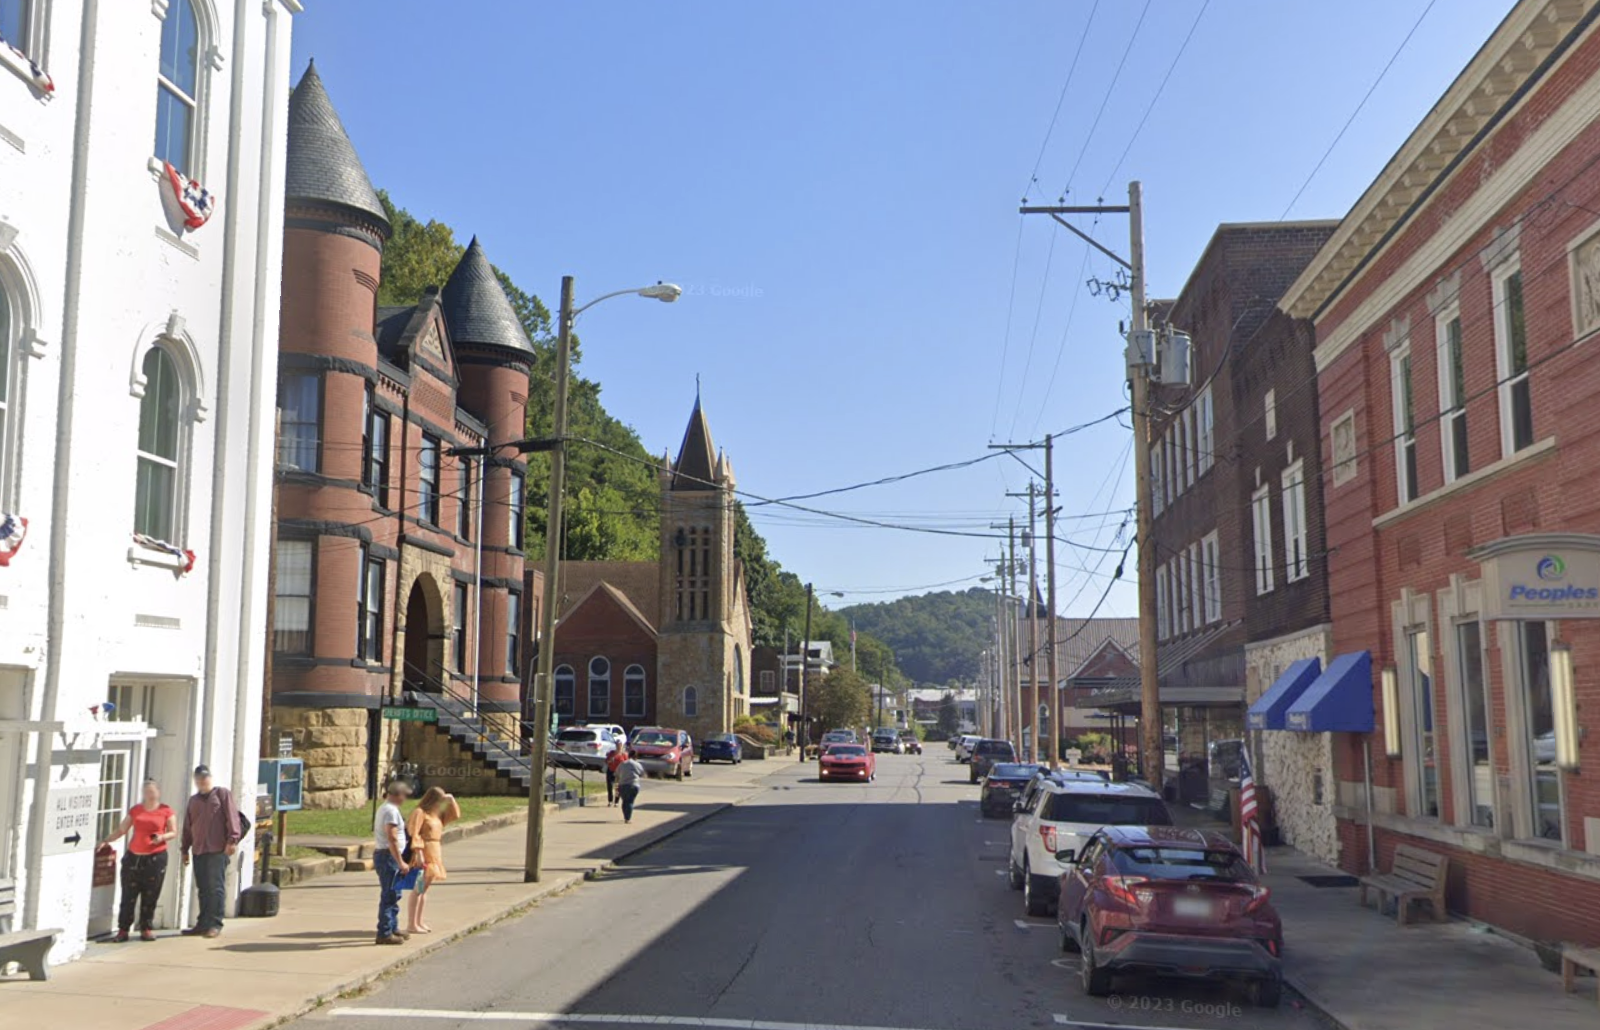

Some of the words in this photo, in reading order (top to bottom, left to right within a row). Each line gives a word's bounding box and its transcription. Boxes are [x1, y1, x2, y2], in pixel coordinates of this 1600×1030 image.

[1510, 584, 1598, 602] Peoples
[57, 796, 67, 811] ALL
[69, 795, 92, 809] VISITORS
[56, 815, 74, 830] ENTER
[75, 813, 90, 827] HERE
